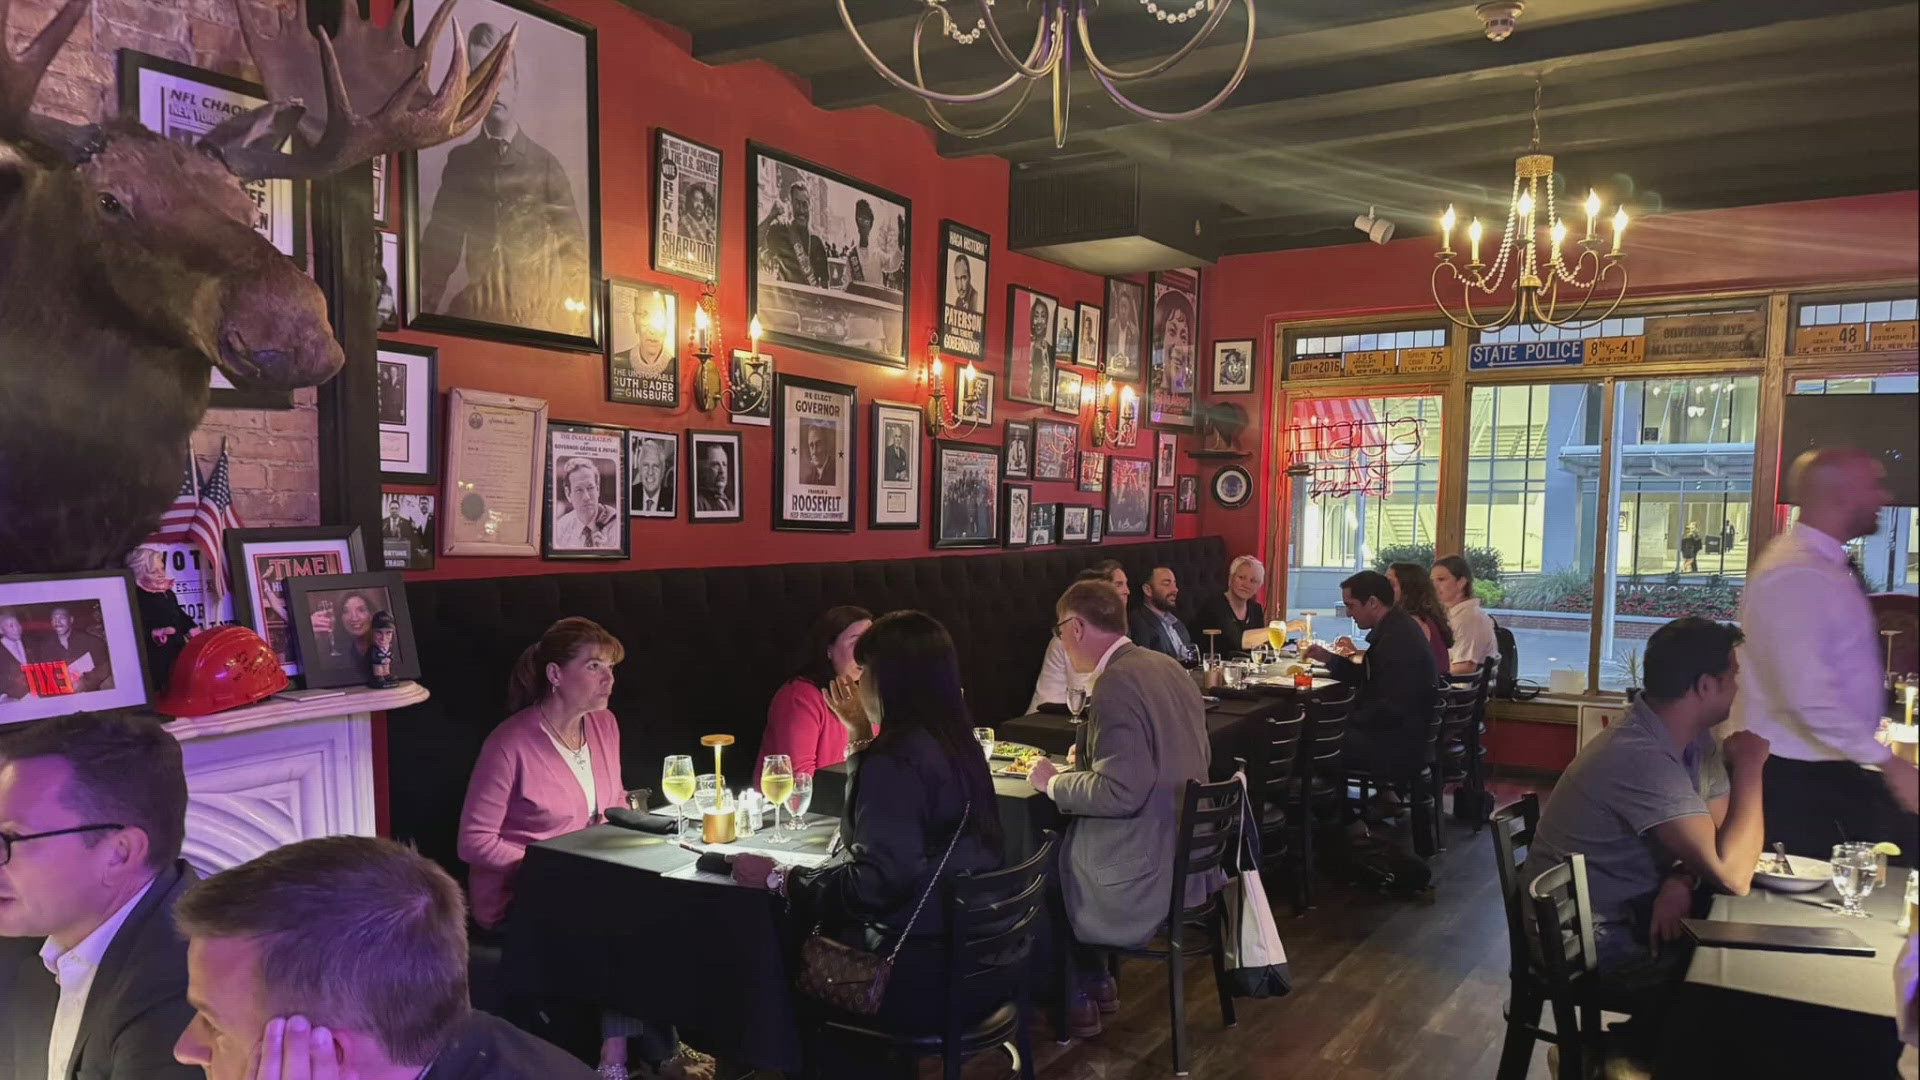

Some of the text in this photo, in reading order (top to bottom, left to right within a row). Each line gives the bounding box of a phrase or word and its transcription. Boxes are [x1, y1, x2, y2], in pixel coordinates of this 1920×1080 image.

[170, 89, 196, 105] NFL
[662, 163, 676, 177] VOTE
[670, 150, 682, 166] THE
[696, 158, 719, 178] SENATE
[661, 231, 715, 268] SHARPTON
[944, 306, 982, 333] PATERSON
[1663, 327, 1720, 338] GOVERNOR
[1839, 327, 1857, 344] 48
[943, 333, 980, 356] GOBERNADOR
[1473, 341, 1581, 363] STATE POLICE
[1431, 351, 1443, 365] 75
[613, 367, 674, 383] THE UNSTOPPABLE
[1290, 360, 1341, 375] HILLARY 2016
[613, 377, 674, 393] RUTH BADER
[625, 388, 674, 402] GINSBURG
[795, 400, 841, 418] GOVERNOR
[791, 494, 842, 513] ROOSEVELT
[268, 557, 328, 581] TIME
